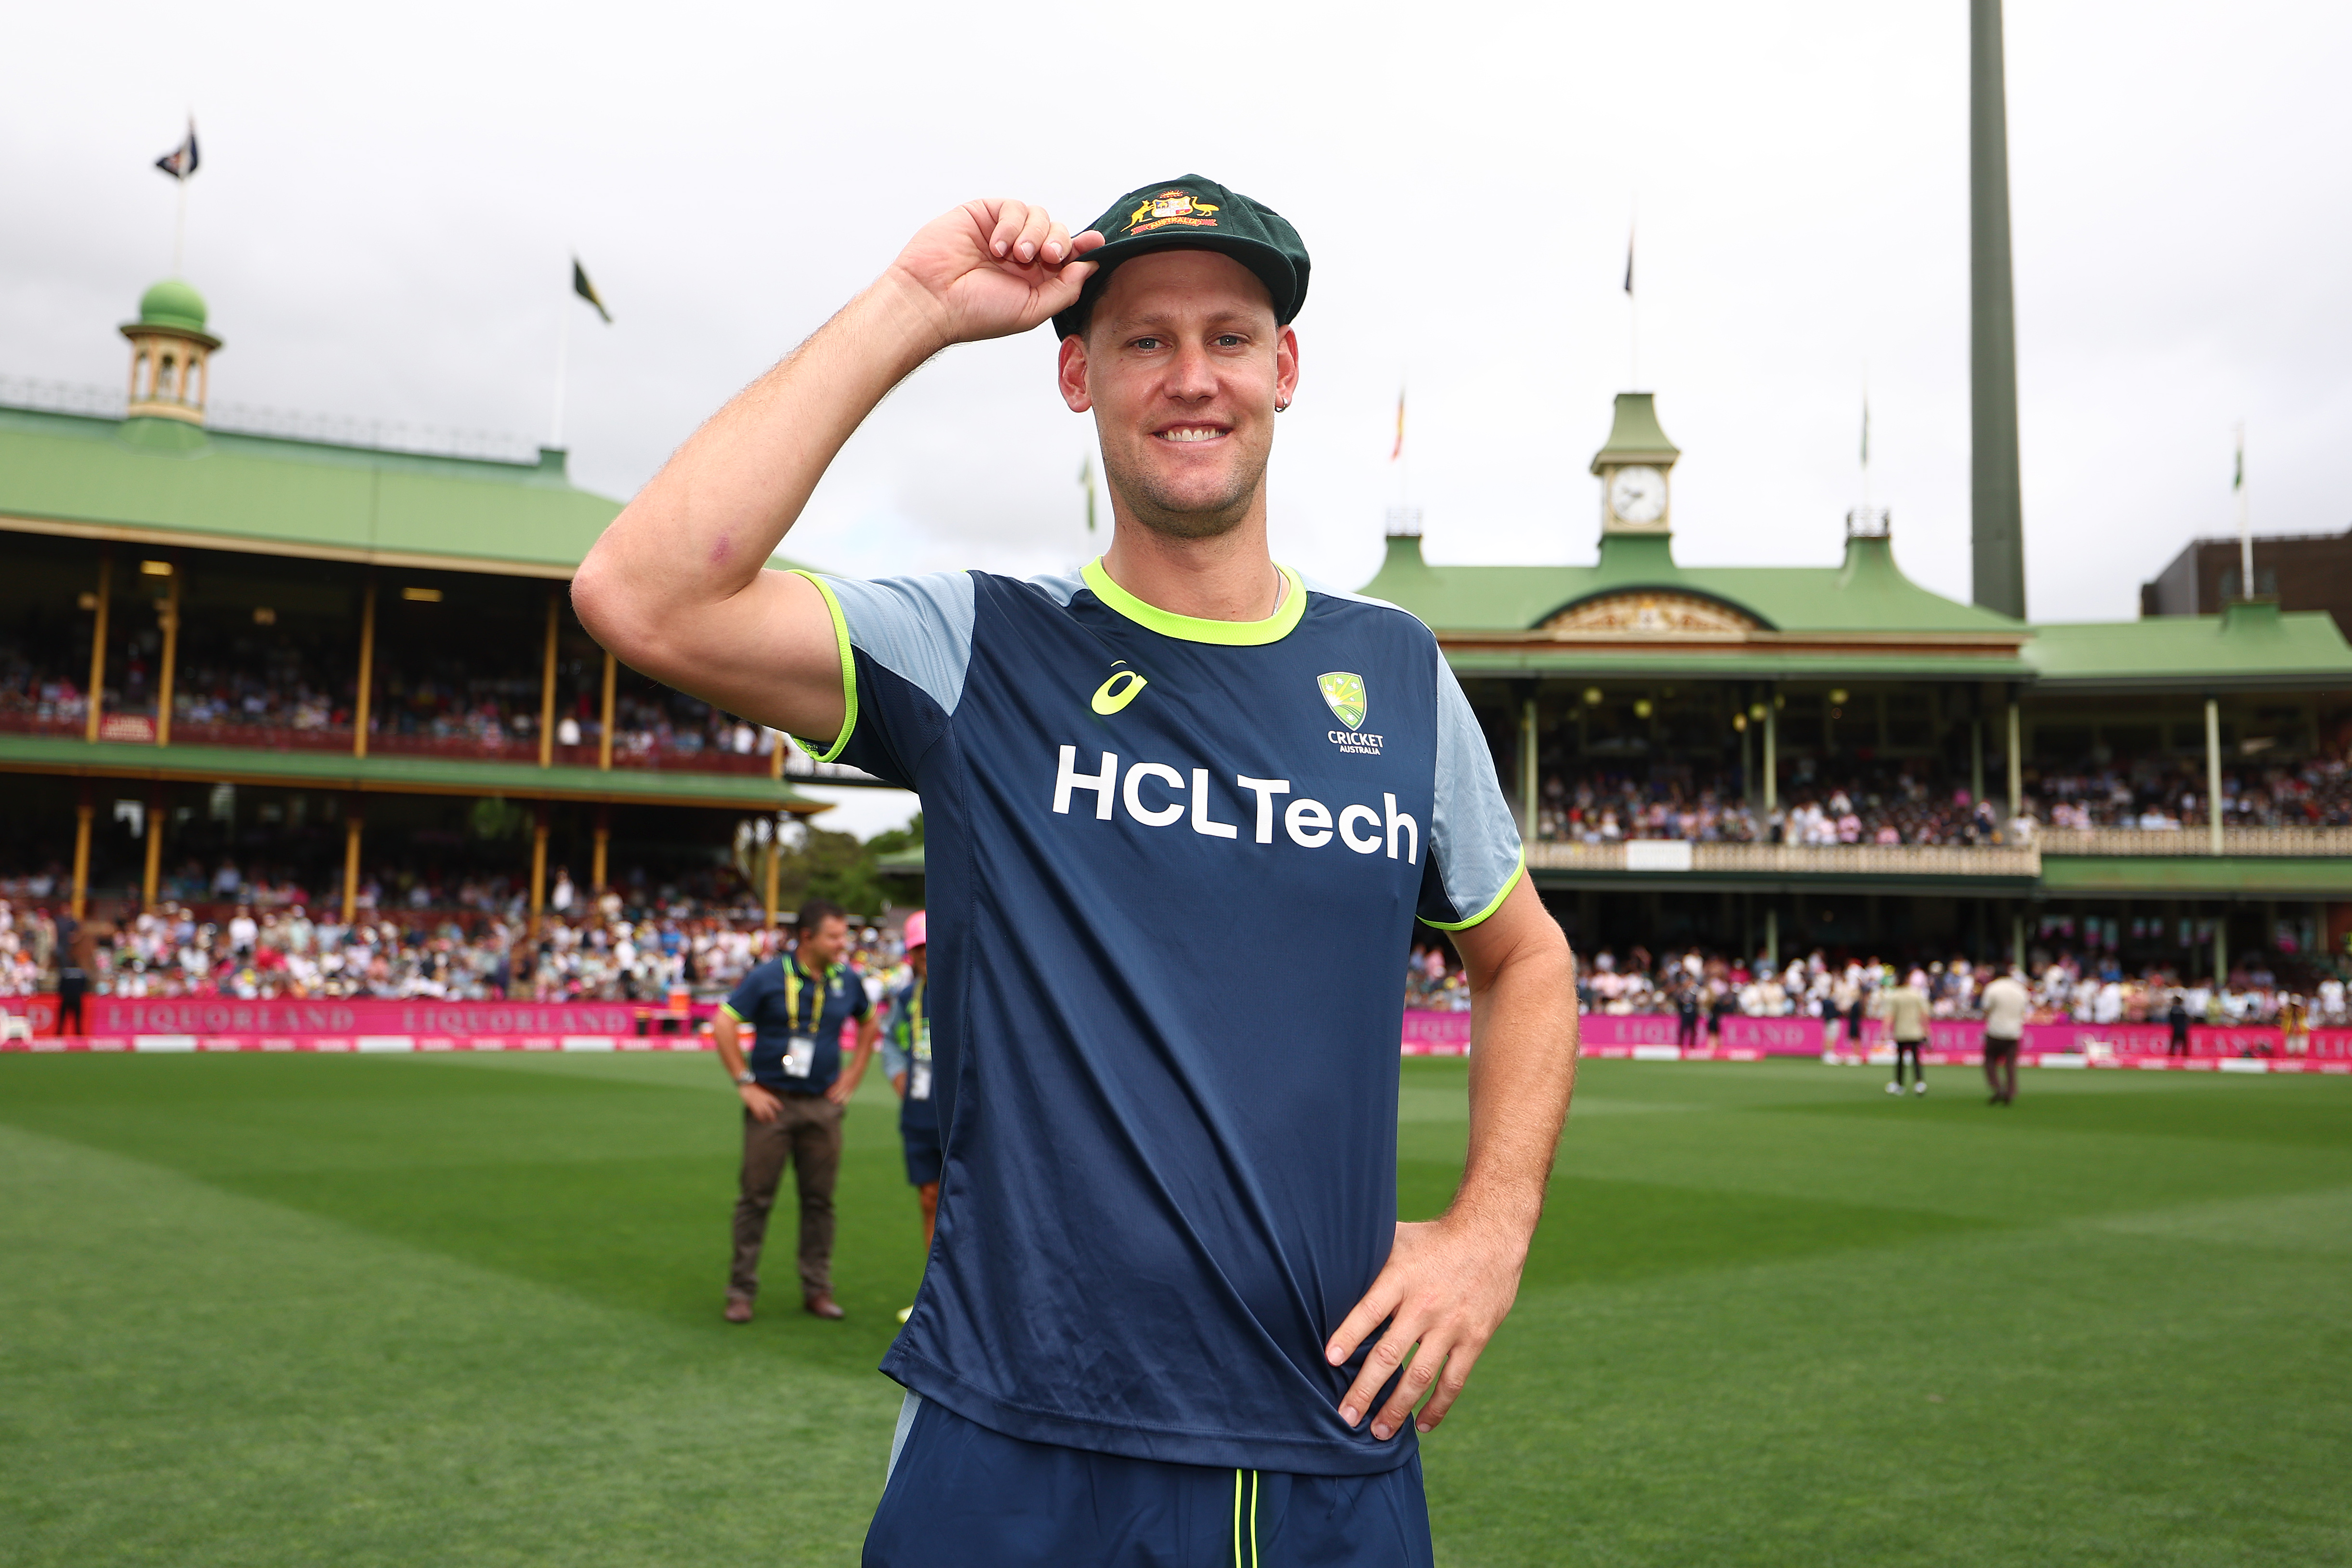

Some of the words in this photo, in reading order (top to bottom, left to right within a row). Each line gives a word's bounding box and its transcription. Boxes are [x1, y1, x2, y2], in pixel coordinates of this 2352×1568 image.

[1150, 216, 1197, 229] AUSTRALIA
[1327, 730, 1383, 748] CRICKET
[1340, 745, 1381, 755] AUSTRALIA
[1052, 745, 1419, 865] HCLTech
[108, 1004, 355, 1034] LIQUORLAND
[402, 1006, 627, 1036] LIQUORLAND
